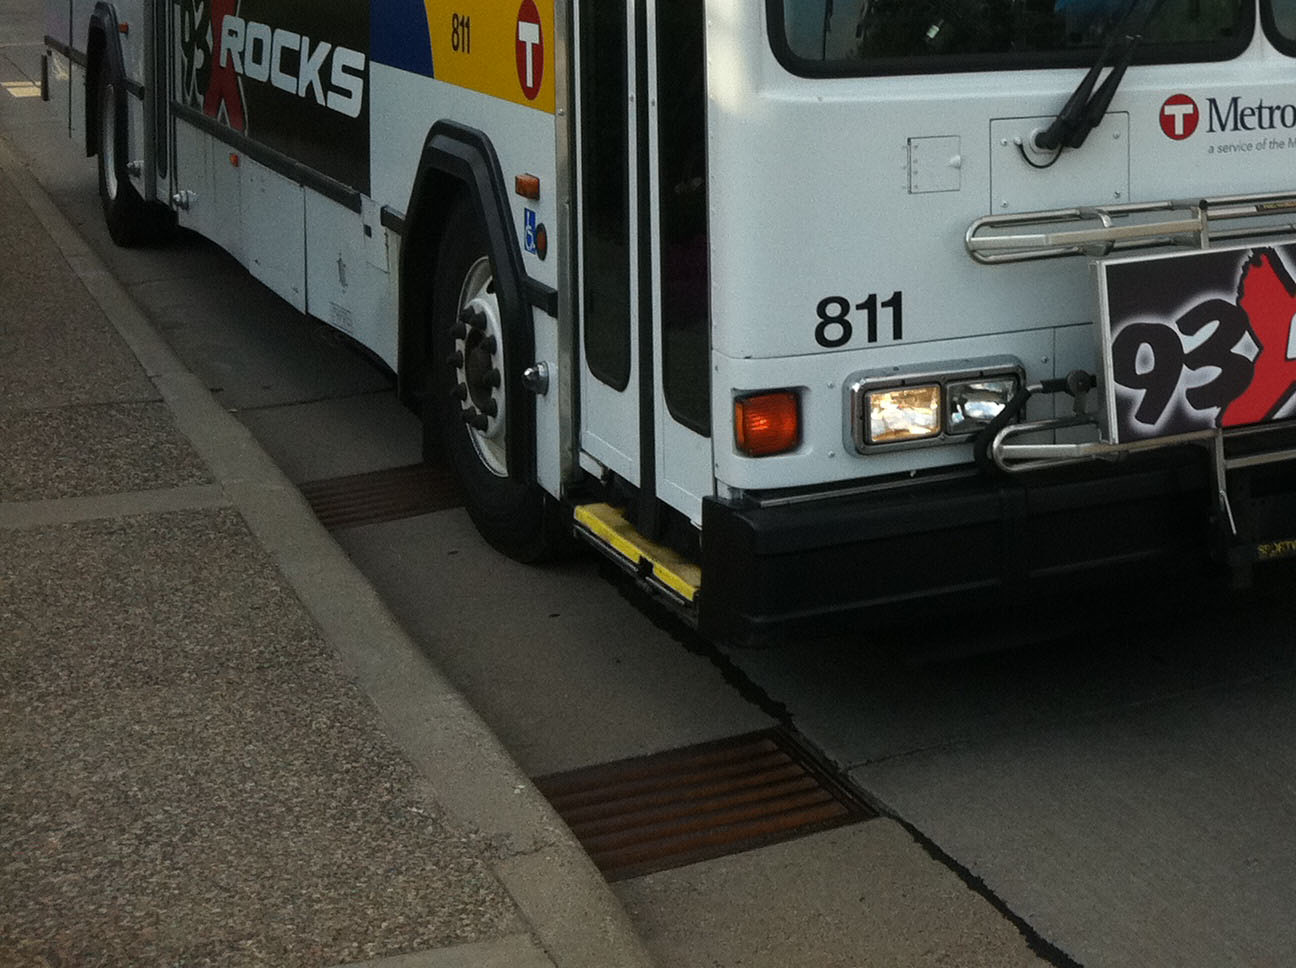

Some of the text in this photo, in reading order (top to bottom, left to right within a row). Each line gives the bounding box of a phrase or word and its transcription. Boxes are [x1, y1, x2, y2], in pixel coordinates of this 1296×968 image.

[451, 12, 471, 55] 811
[219, 13, 366, 119] ROCKS
[1216, 138, 1253, 154] service
[1255, 137, 1269, 151] of
[1269, 136, 1286, 150] the
[814, 290, 904, 349] 811
